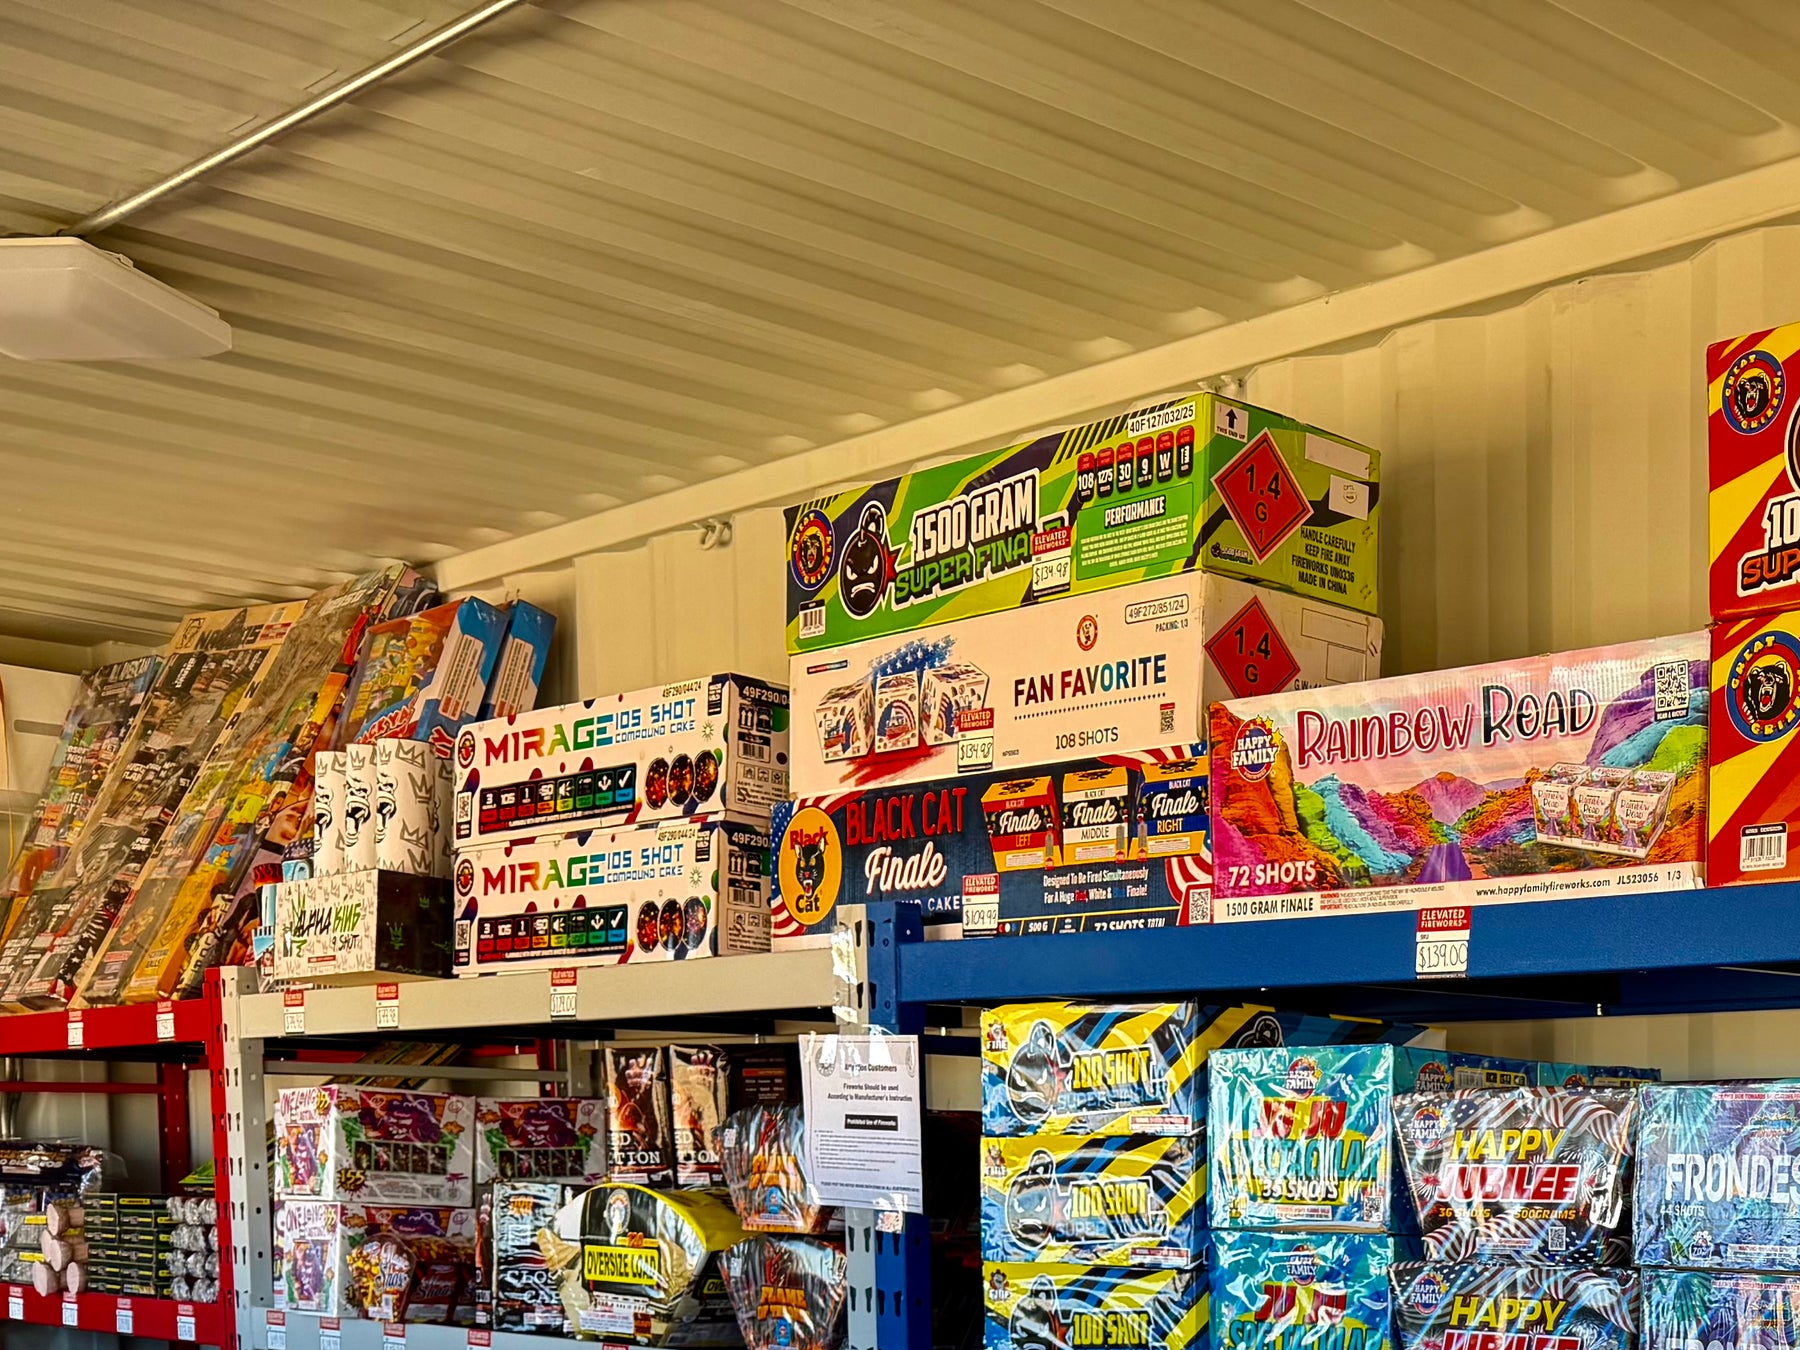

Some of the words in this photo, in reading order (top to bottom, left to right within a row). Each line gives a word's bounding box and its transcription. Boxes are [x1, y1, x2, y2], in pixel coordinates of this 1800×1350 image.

[1128, 408, 1195, 435] 40F127/032/25
[913, 500, 969, 563] 1500
[969, 478, 1035, 540] GRAM
[1104, 495, 1166, 528] PERFORMANCE
[1300, 525, 1322, 546] HANDLE
[1323, 532, 1357, 554] CAREFULLY
[1305, 543, 1319, 559] KEEP
[1320, 547, 1333, 562] FIRE
[1334, 551, 1350, 567] AWAY
[1299, 570, 1318, 587] MADE
[1327, 576, 1347, 596] CHINA
[1014, 672, 1054, 708] FAN
[1060, 653, 1168, 701] FAVORITE
[1483, 684, 1597, 746] ROAD
[483, 713, 614, 767] MIRAGE
[650, 699, 696, 723] SHOT
[1055, 731, 1076, 750] 108
[1078, 726, 1119, 748] SHOTS
[1237, 734, 1272, 754] HAPPY
[846, 792, 916, 846] BLACK
[921, 787, 969, 834] CAT
[1072, 799, 1118, 826] Finale
[1151, 790, 1199, 818] Finale
[999, 809, 1041, 836] Finale
[482, 854, 606, 897] MIRAGE
[641, 845, 684, 867] SHOT
[864, 840, 948, 896] Finale
[1043, 872, 1070, 888] Designed
[1228, 866, 1249, 886] 72
[1255, 860, 1316, 884] SHOTS
[1476, 876, 1611, 899] www.happyfamilyfireworks.com
[1225, 902, 1249, 917] 1500
[1252, 900, 1279, 916] GRAM
[1282, 896, 1314, 914] FINALE
[1421, 907, 1466, 922] ELEVATED
[1417, 942, 1468, 971] $139.00
[1451, 1128, 1569, 1161] HAPPY
[1436, 1164, 1581, 1202] JUBILEE
[586, 1254, 630, 1280] OVERSIZE
[631, 1252, 658, 1281] LOAD
[1449, 1299, 1569, 1332] HAPPY
